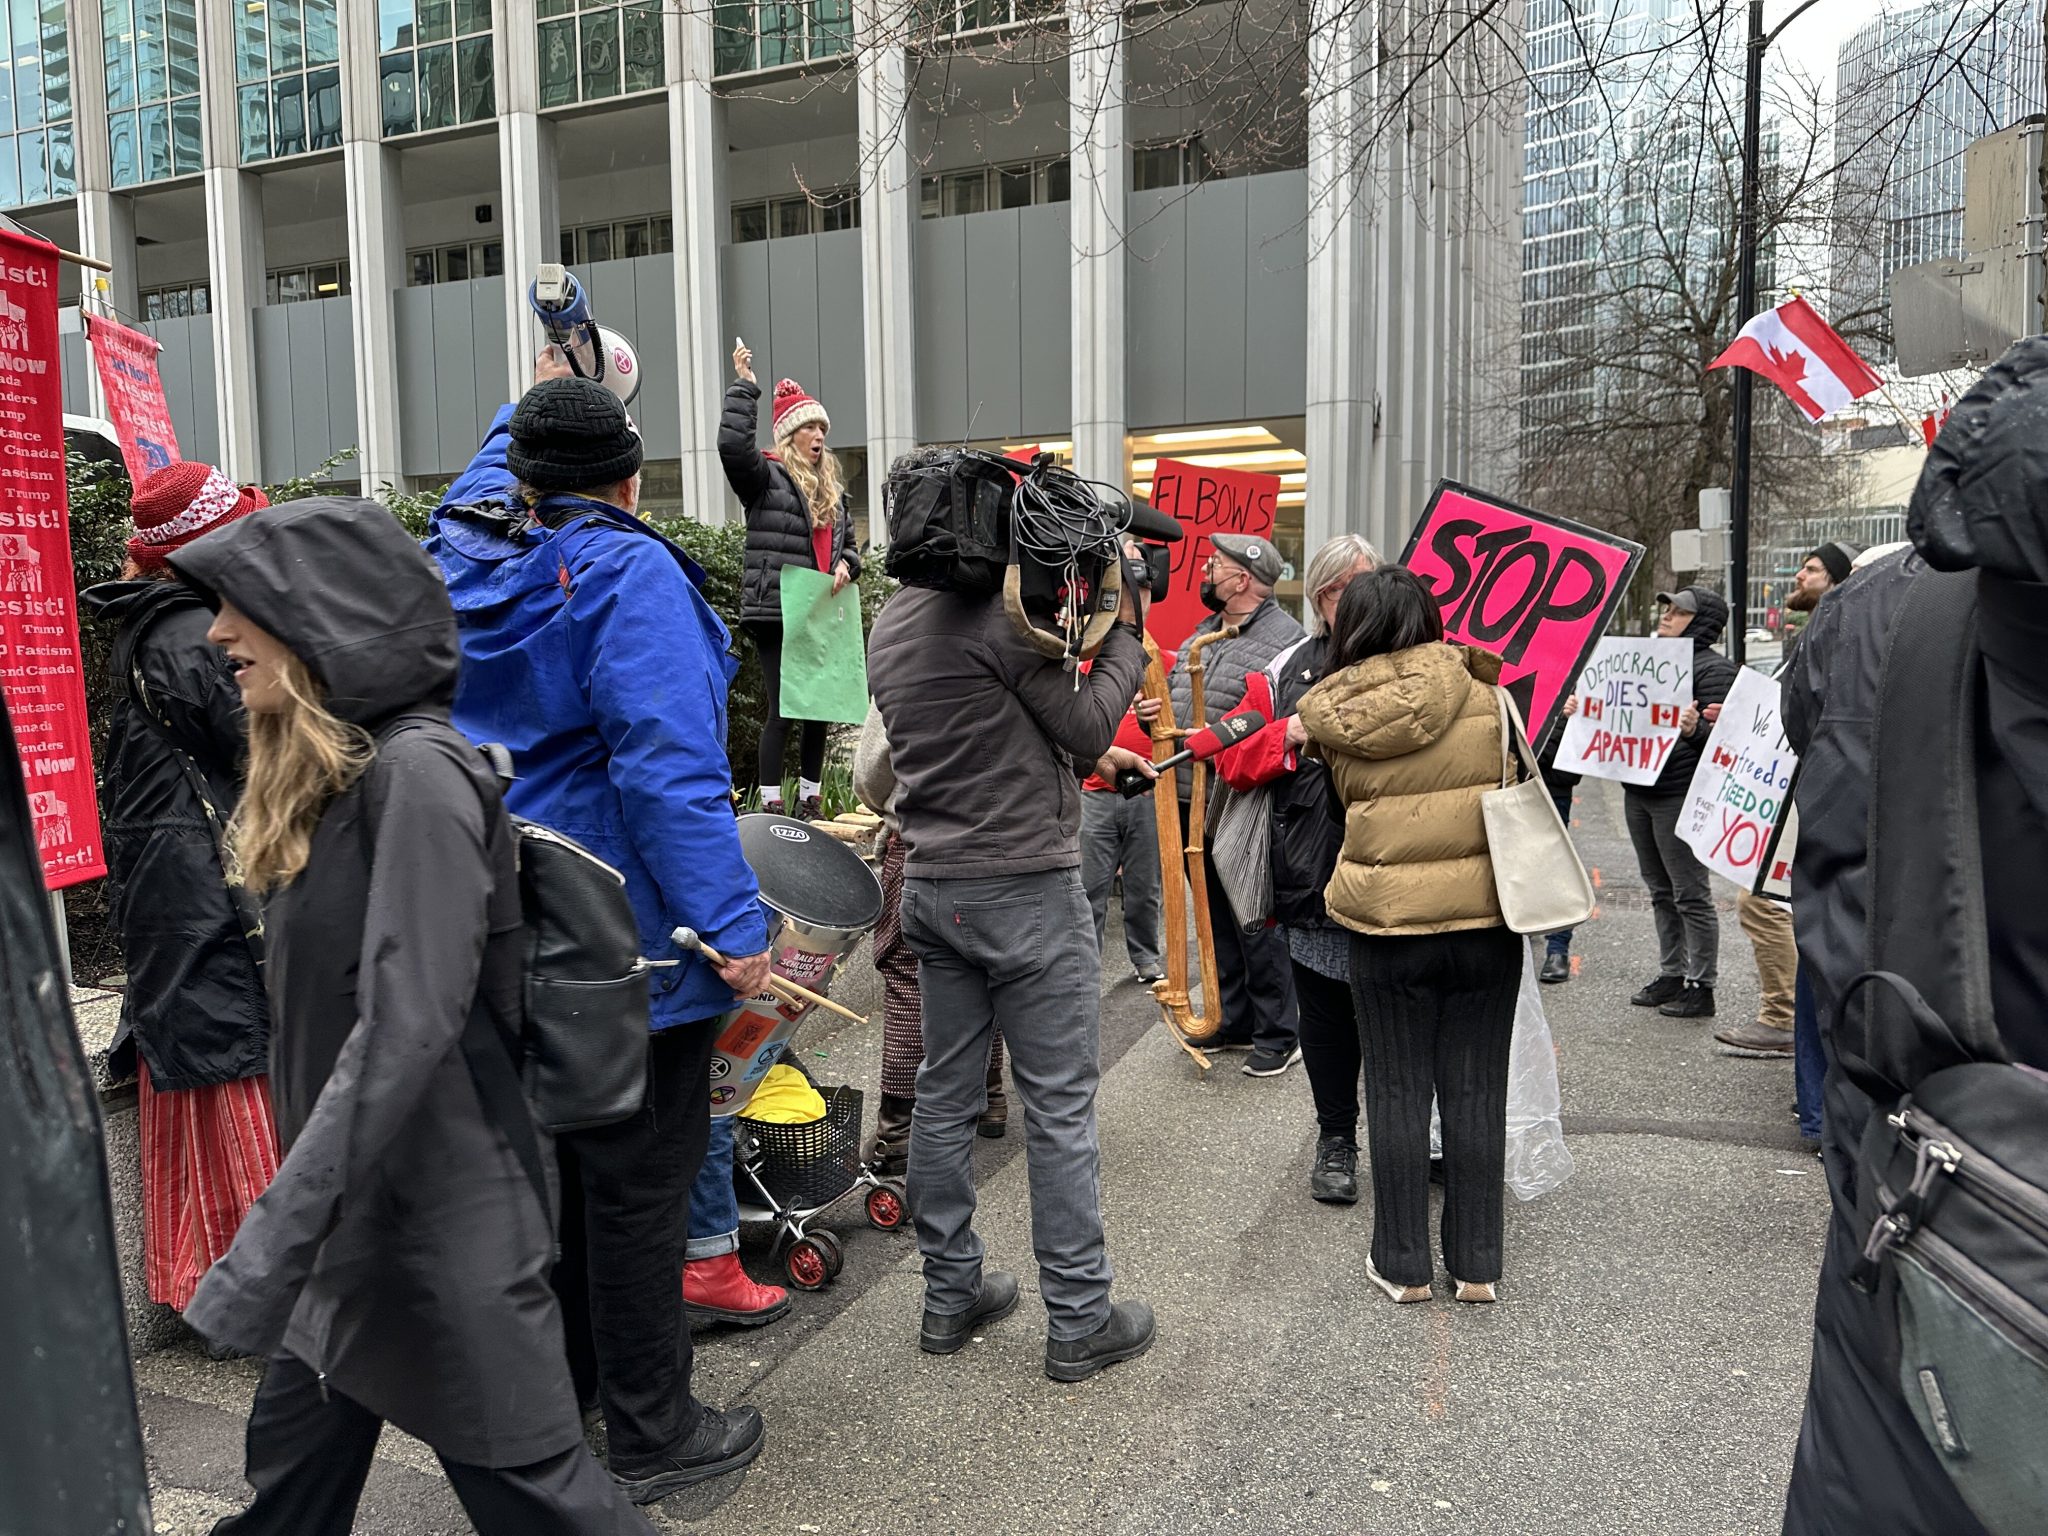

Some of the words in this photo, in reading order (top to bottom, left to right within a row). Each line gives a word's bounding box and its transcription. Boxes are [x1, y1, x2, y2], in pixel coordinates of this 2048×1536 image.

[4, 444, 60, 459] Canada
[0, 467, 54, 481] ascism
[5, 487, 51, 502] Trump
[1419, 519, 1607, 667] STOP
[22, 624, 65, 637] Trump
[15, 644, 73, 656] Fascism
[26, 663, 75, 676] Canada
[1584, 652, 1689, 692] DEMOCRACY
[1606, 681, 1649, 708] DIES
[1610, 708, 1634, 734] IN
[1752, 703, 1773, 738] We
[1582, 729, 1674, 772] APATHY
[34, 757, 75, 777] Now
[781, 958, 814, 971] SCHLUSS
